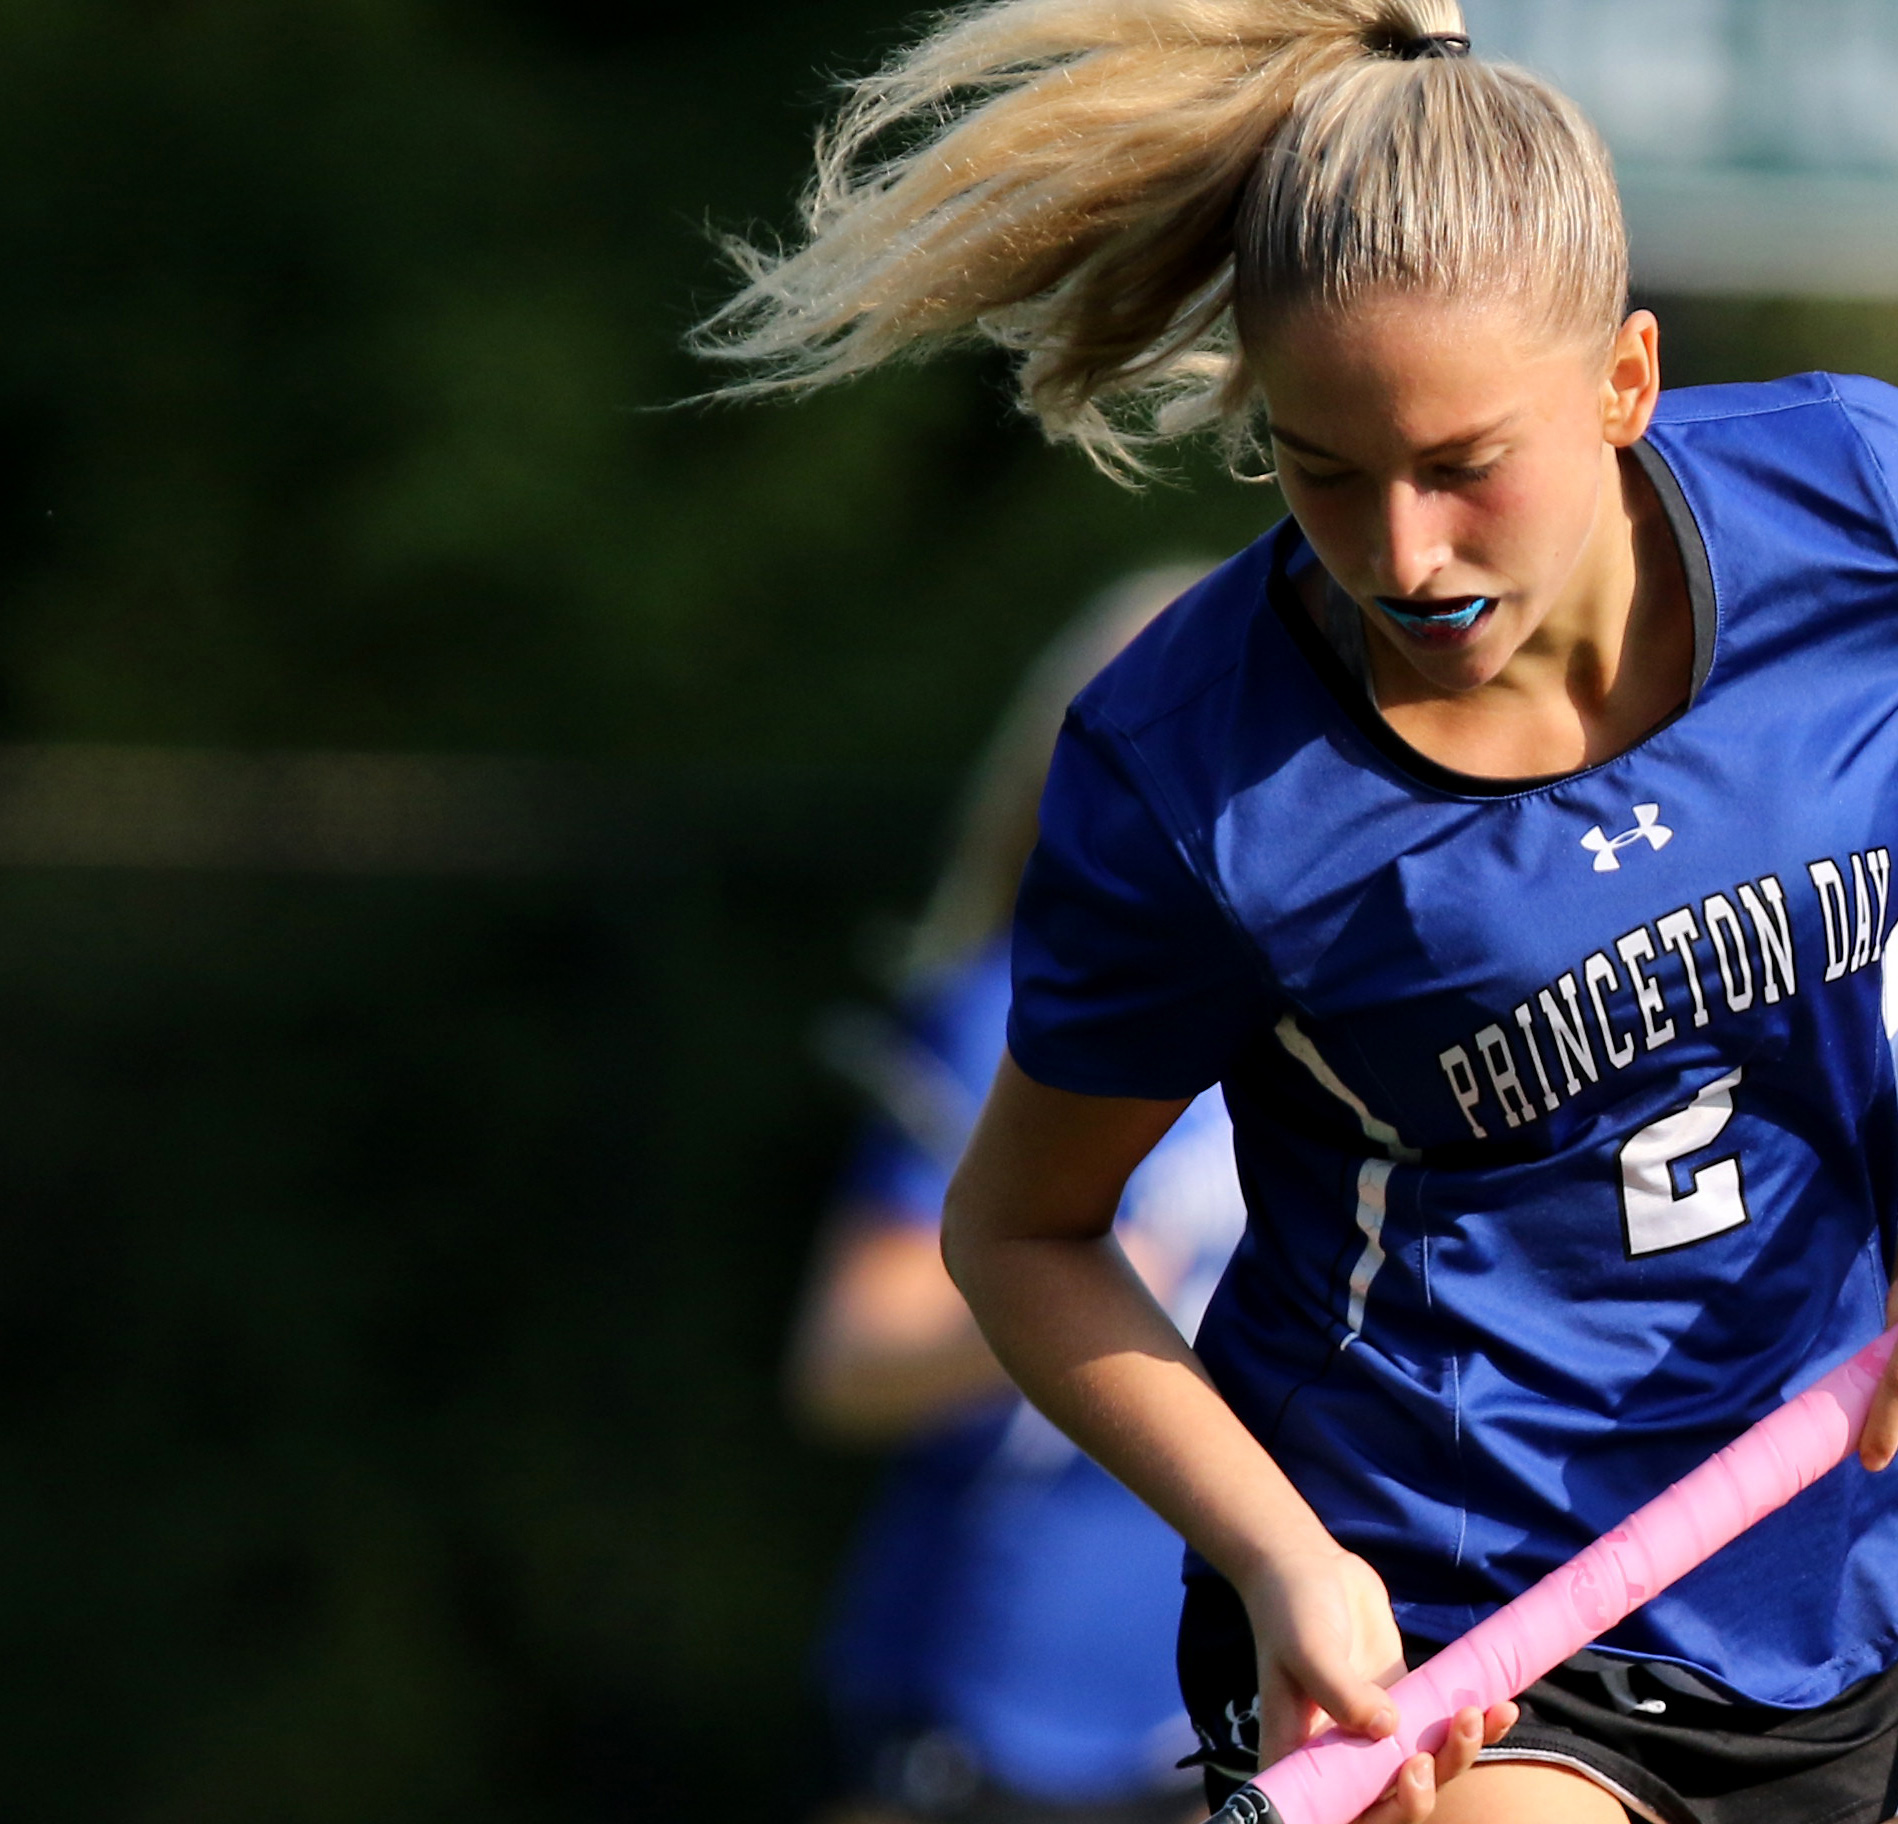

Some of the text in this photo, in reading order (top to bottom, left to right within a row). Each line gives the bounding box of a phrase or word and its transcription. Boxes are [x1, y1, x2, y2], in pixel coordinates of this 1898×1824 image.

[1438, 847, 1891, 1140] PRINCETON DAY
[1618, 1064, 1752, 1261] 2
